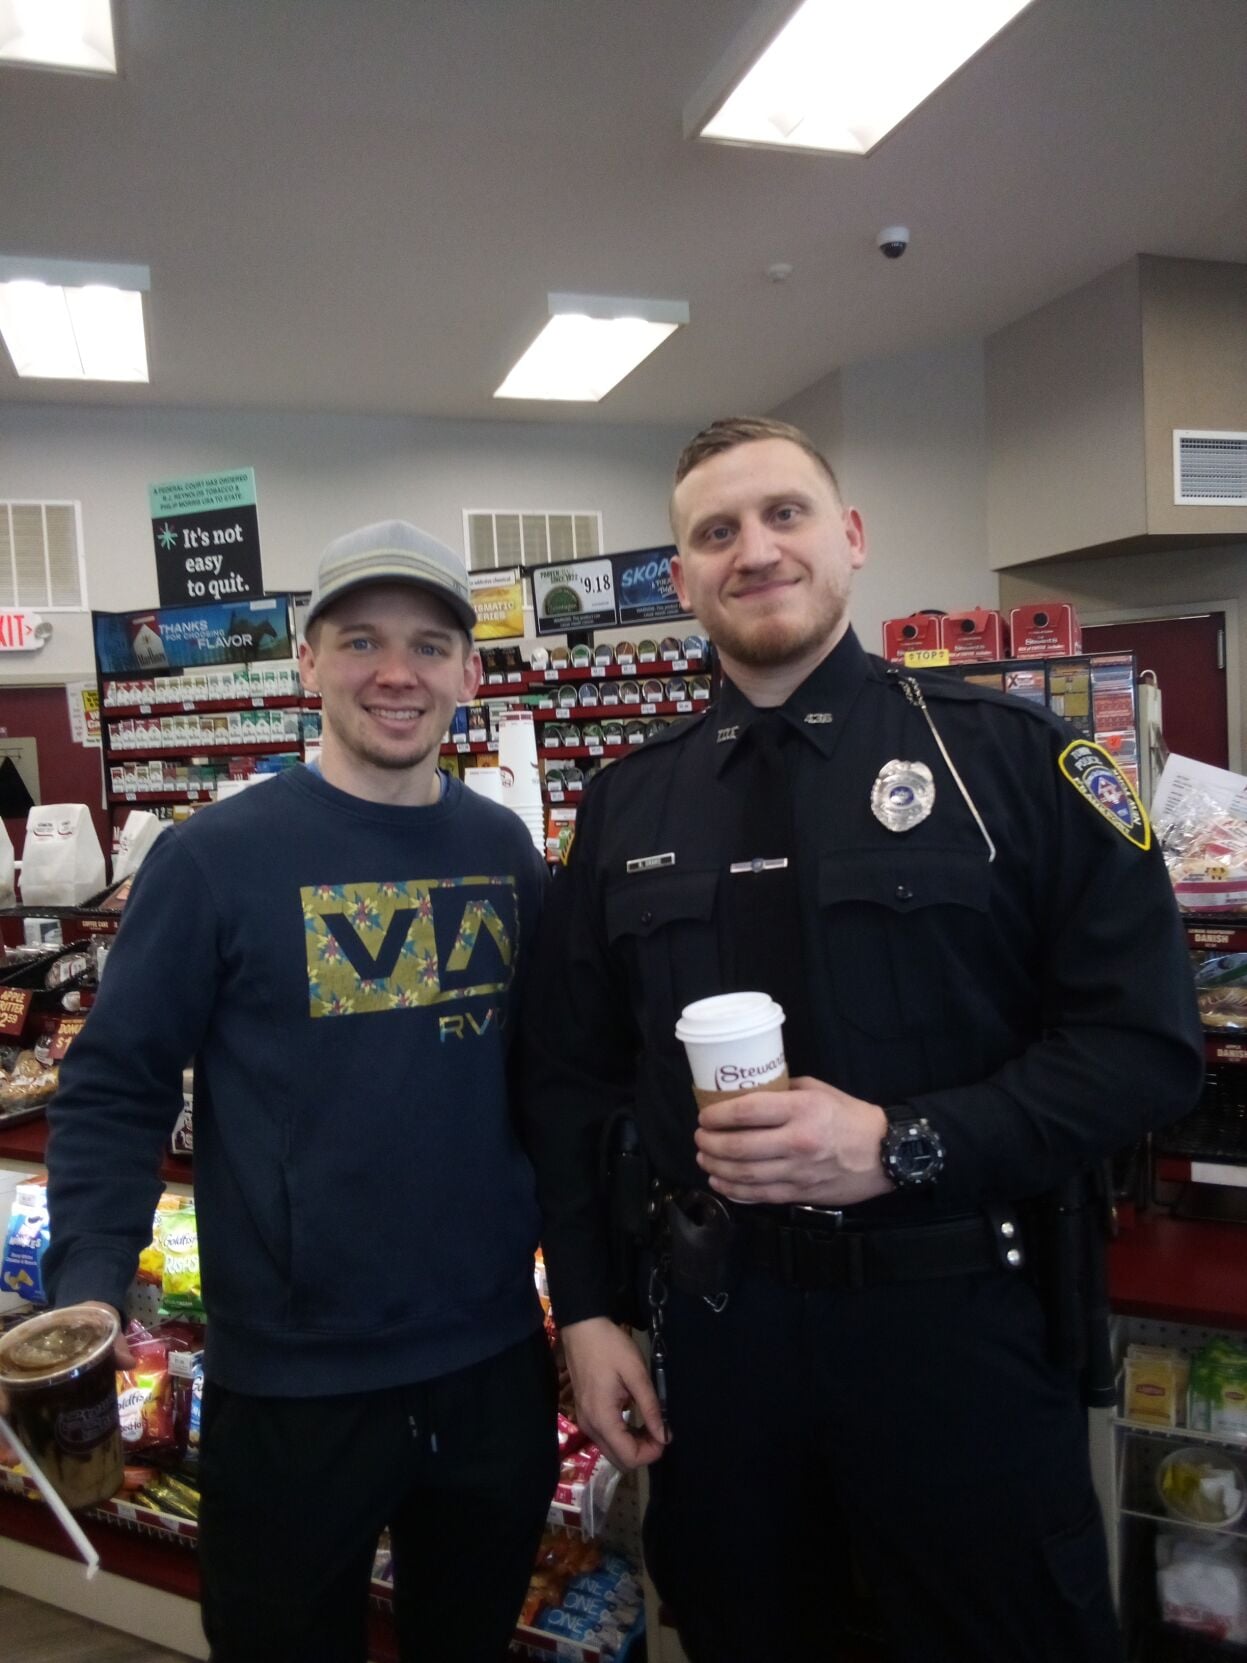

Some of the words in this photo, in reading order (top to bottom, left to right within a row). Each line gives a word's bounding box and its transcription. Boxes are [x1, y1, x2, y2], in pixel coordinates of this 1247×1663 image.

[182, 527, 210, 549] It's
[212, 524, 244, 545] not
[185, 554, 223, 576] easy
[621, 557, 669, 587] SKOA
[187, 578, 205, 597] to
[208, 571, 250, 600] quit.
[159, 620, 208, 635] THANKS
[197, 633, 253, 650] FLAVOR
[1194, 933, 1230, 944] DANISH
[0, 990, 26, 1003] APPLE
[0, 1000, 25, 1015] RITTER
[719, 1053, 785, 1084] Stewar
[563, 1591, 603, 1615] ONE
[547, 1608, 585, 1634] ONE
